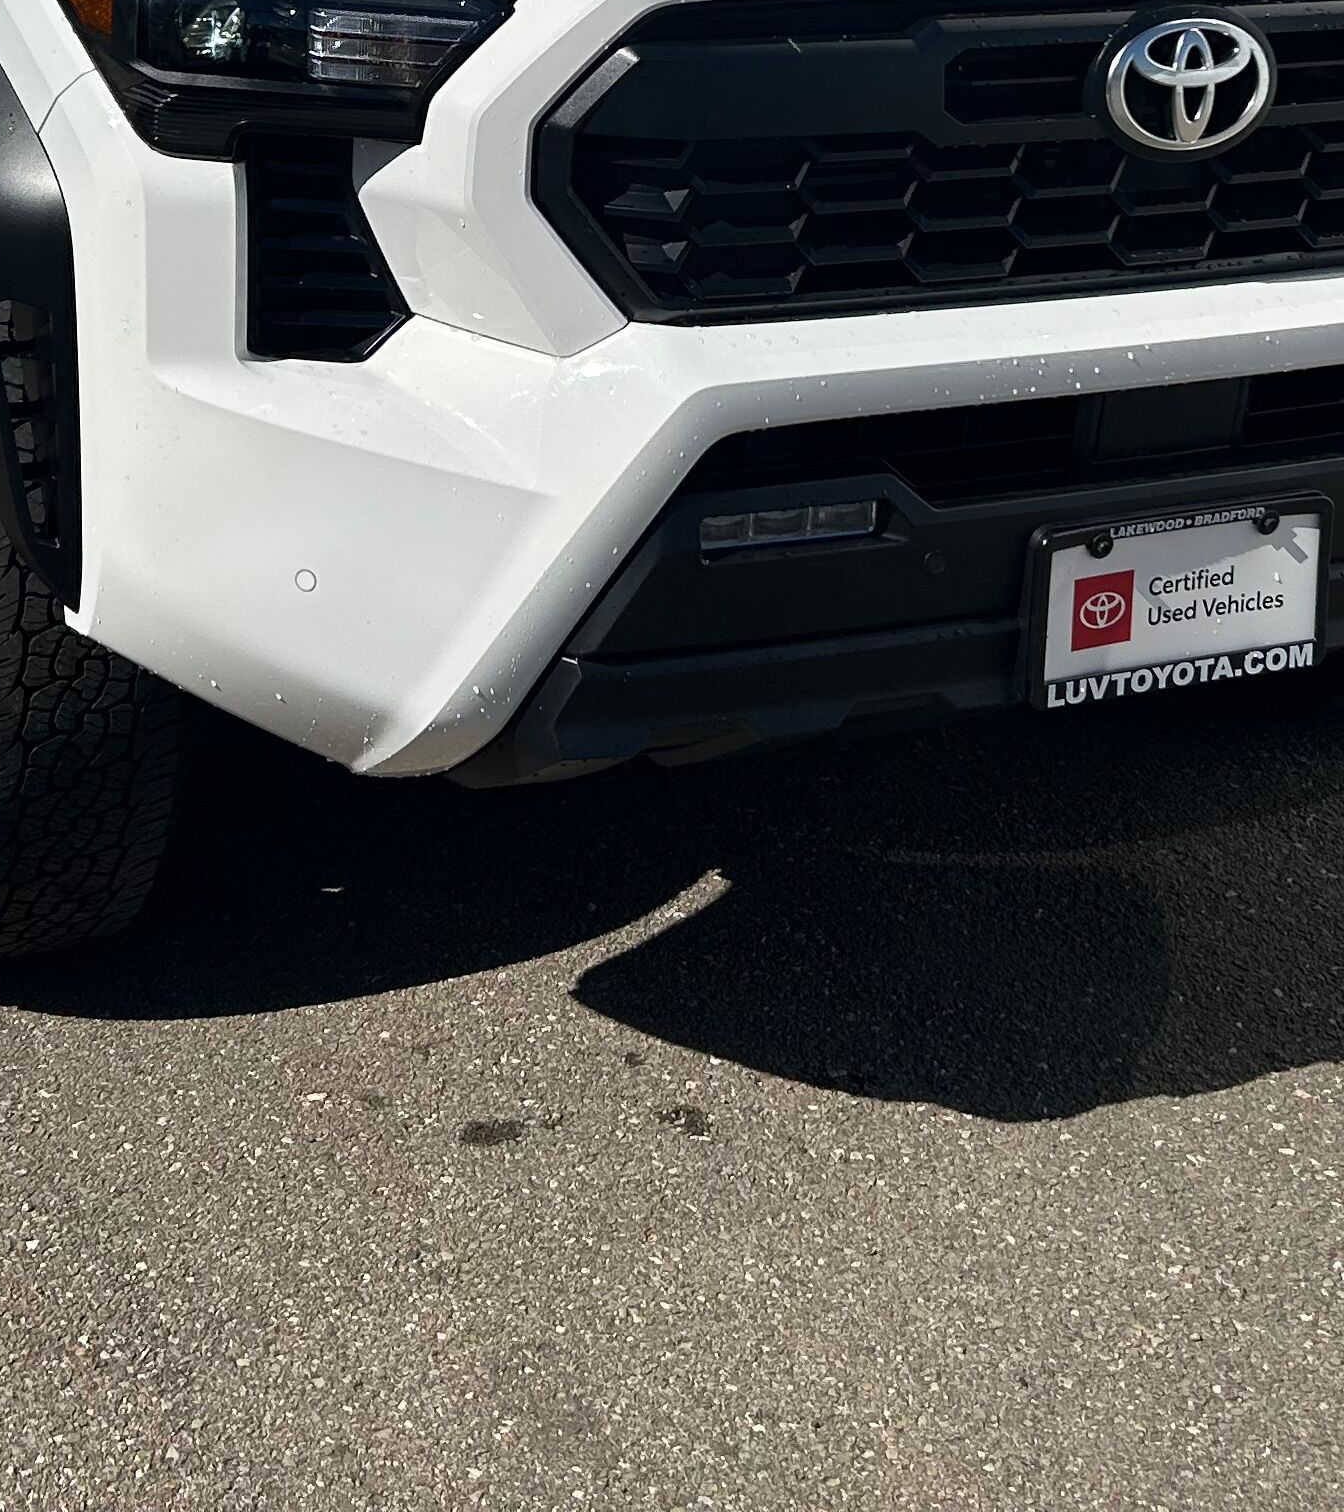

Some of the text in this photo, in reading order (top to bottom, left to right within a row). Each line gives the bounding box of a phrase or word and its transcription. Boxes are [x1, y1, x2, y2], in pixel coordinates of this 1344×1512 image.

[1109, 506, 1266, 538] LAKEWOOD BRADFORD
[1148, 564, 1235, 597] Certified
[1147, 590, 1285, 626] Used Vehicles
[1046, 641, 1315, 709] LUVTOYOTA.COM
